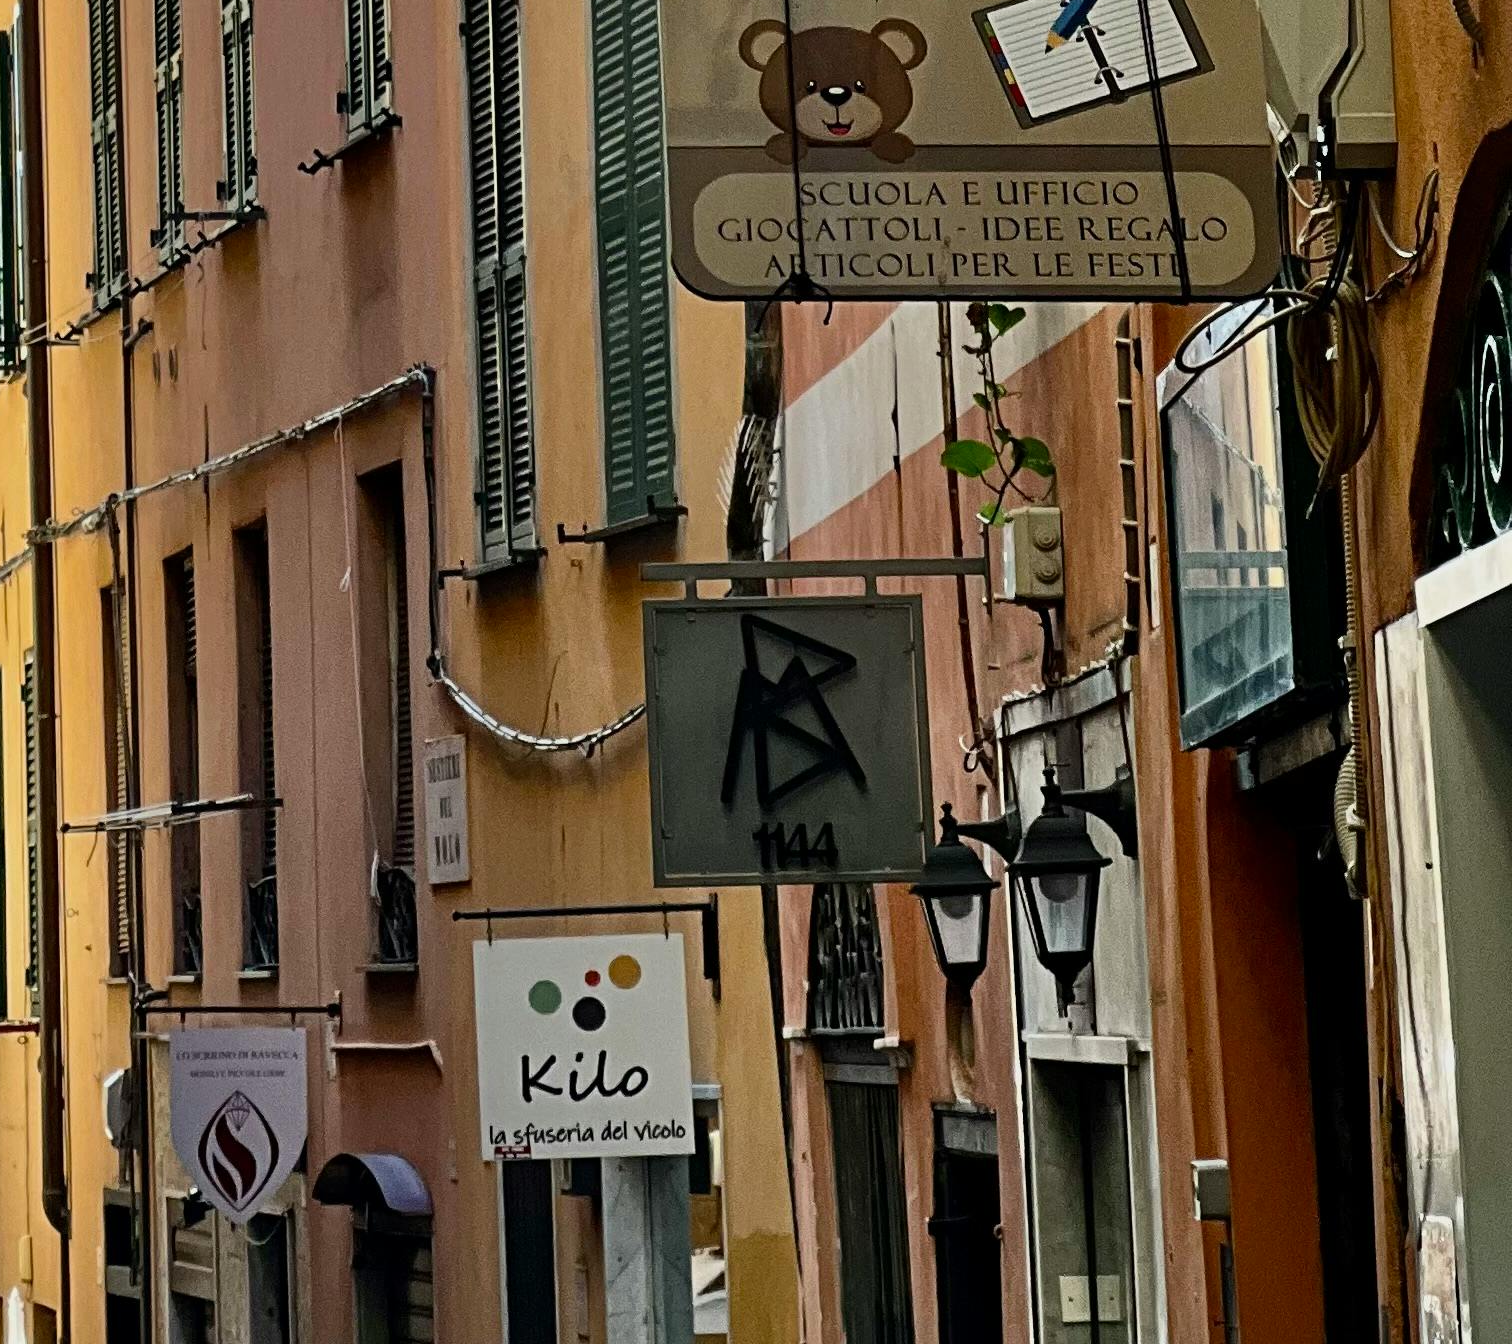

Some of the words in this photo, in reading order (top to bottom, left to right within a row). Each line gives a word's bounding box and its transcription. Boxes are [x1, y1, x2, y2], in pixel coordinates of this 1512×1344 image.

[800, 181, 947, 206] SCUOLA
[963, 181, 981, 206] E
[996, 180, 1139, 206] UFFICIO
[717, 216, 941, 243] GIOCATTOLI
[982, 216, 1065, 242] IDEE
[1077, 216, 1228, 243] REGALO
[764, 252, 935, 278] ARTICOLI
[951, 252, 1017, 278] PER
[1033, 252, 1074, 278] LE
[752, 822, 839, 869] 1144
[521, 1049, 649, 1103] Kilo
[489, 1124, 507, 1145] la
[514, 1122, 594, 1147] sfuseria
[601, 1120, 628, 1142] del
[634, 1119, 686, 1141] vicolo
